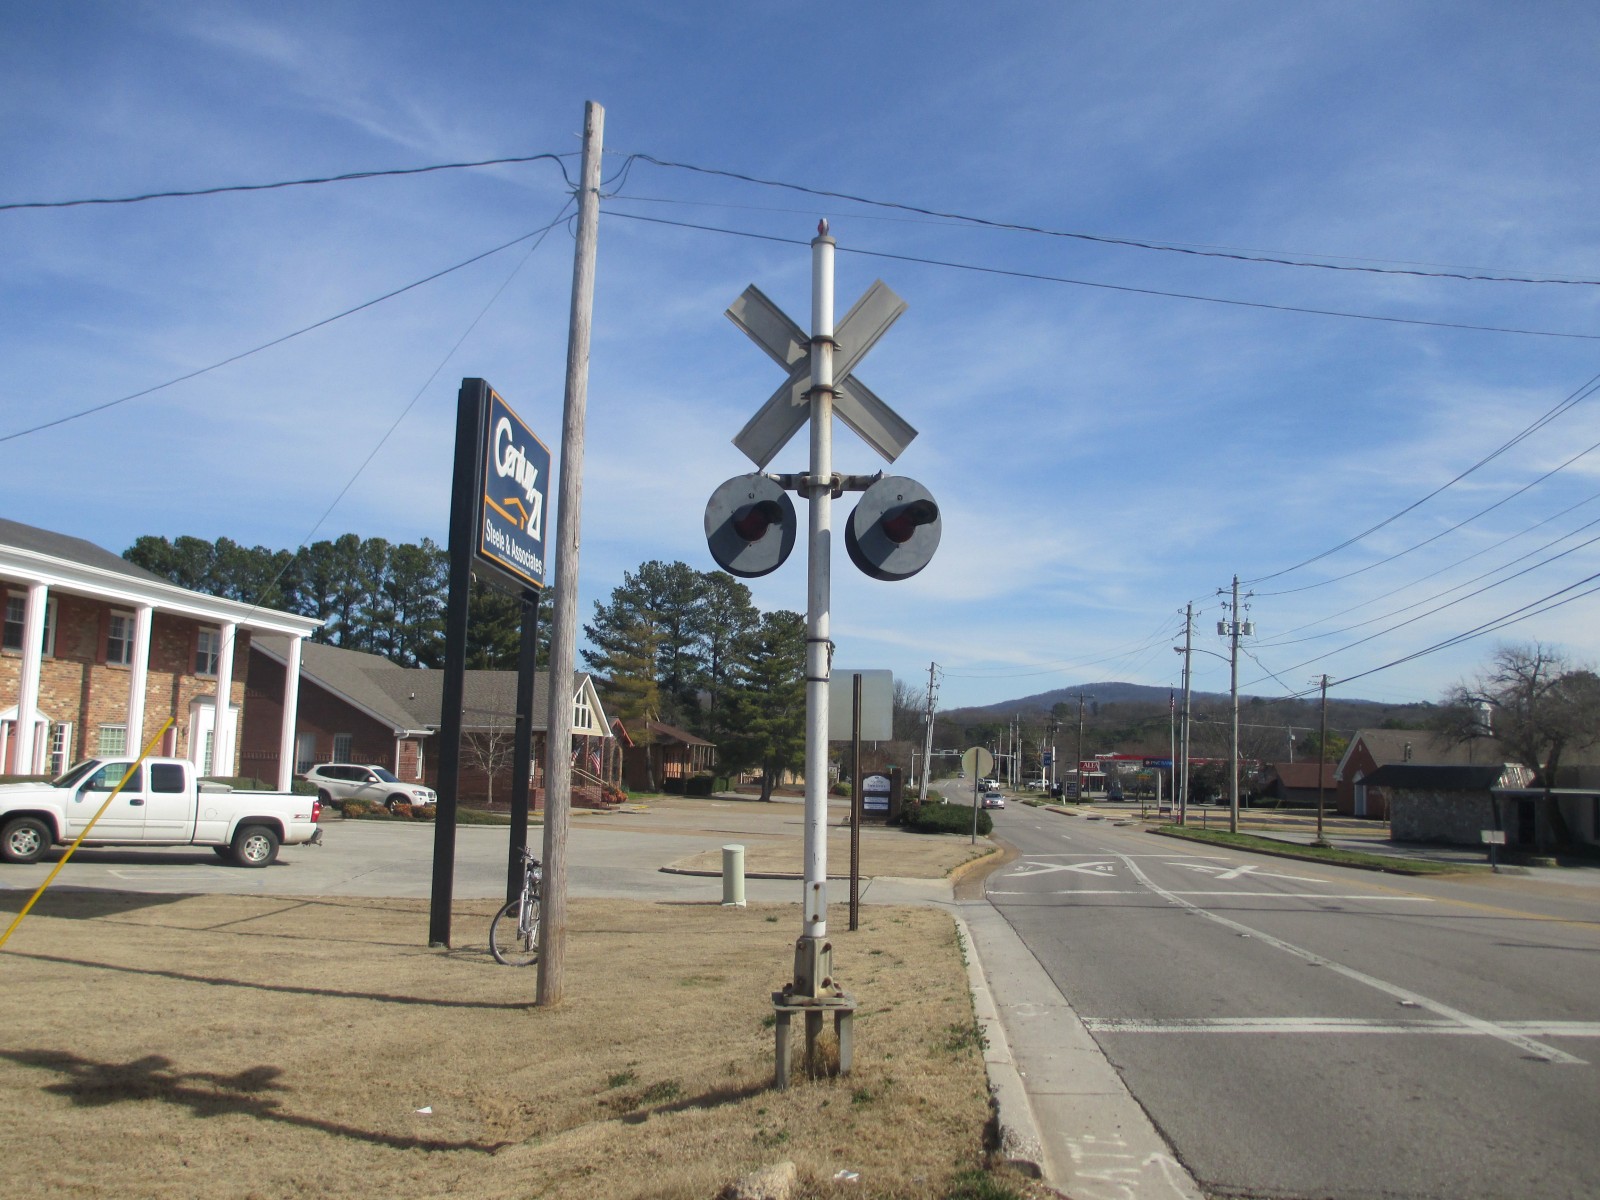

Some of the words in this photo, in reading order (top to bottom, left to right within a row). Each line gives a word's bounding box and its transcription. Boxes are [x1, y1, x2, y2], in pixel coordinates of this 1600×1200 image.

[495, 417, 538, 500] Century
[527, 487, 542, 542] 21
[486, 518, 505, 551] Steele
[506, 534, 511, 556] &
[512, 538, 543, 575] Associates
